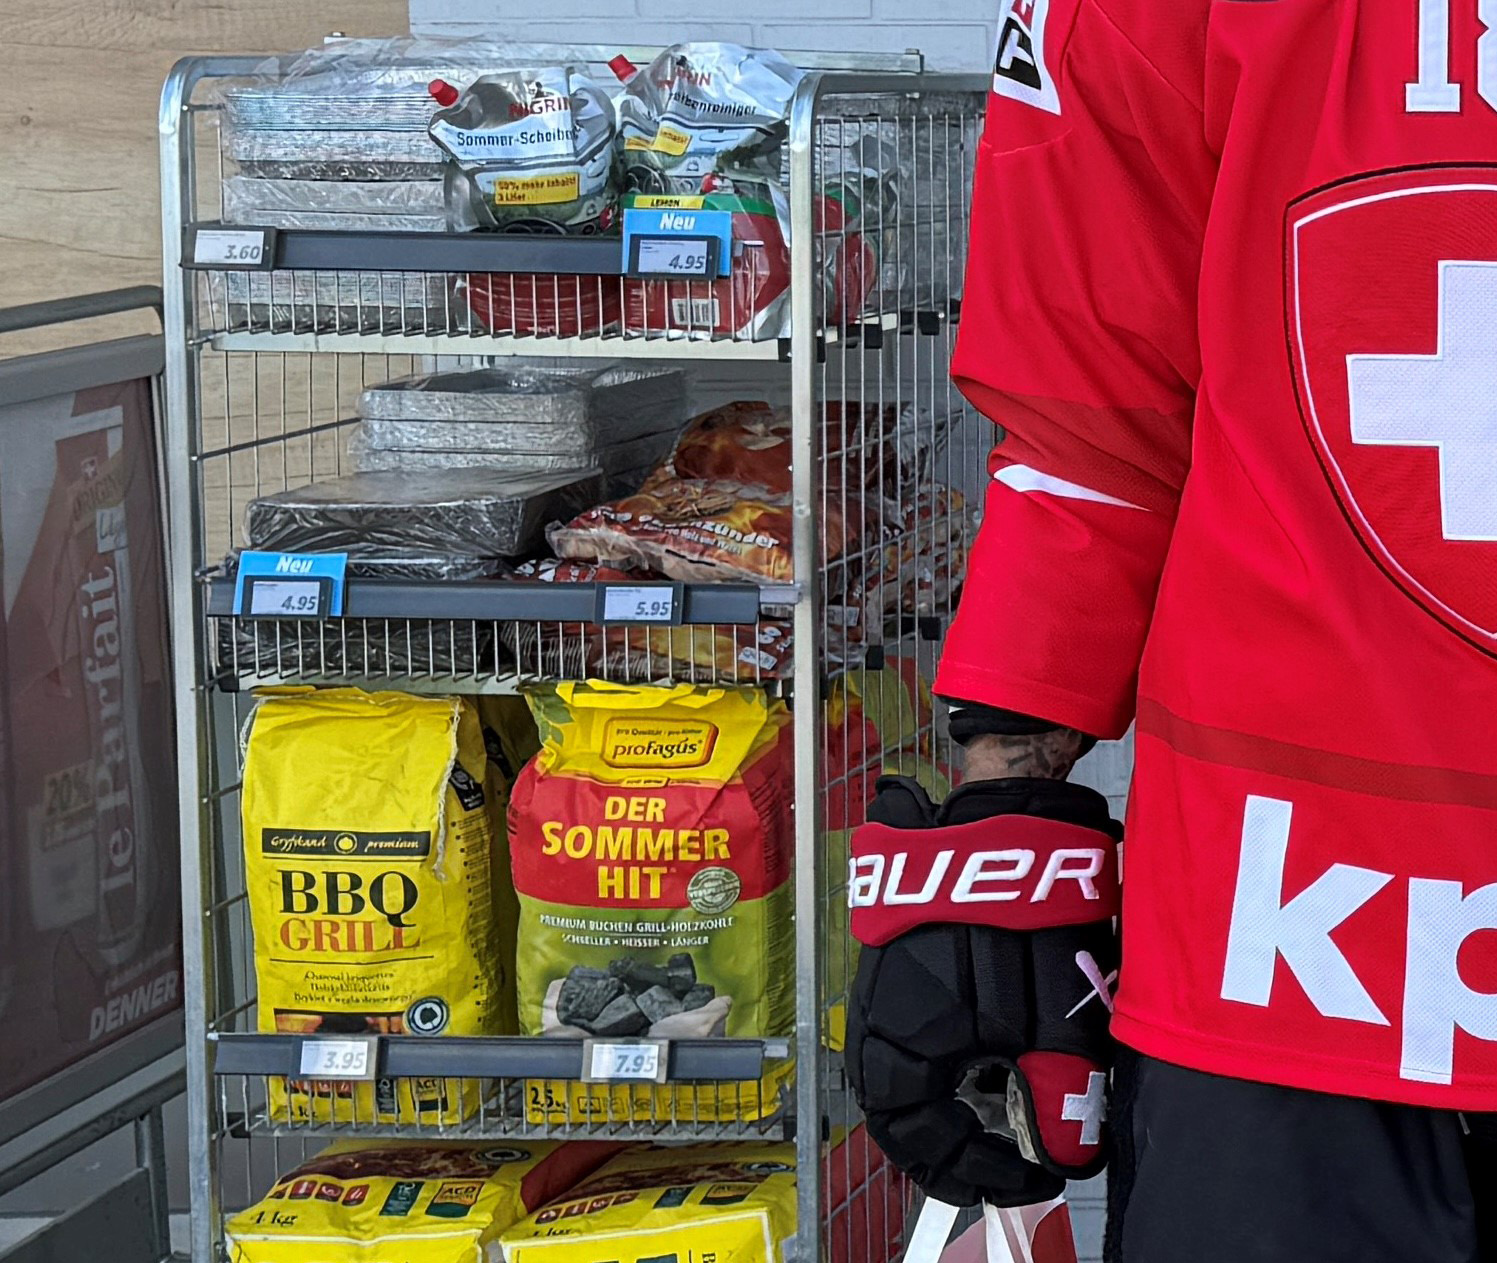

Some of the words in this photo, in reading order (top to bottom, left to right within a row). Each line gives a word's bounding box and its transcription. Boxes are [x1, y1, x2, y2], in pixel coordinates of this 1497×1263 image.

[660, 212, 696, 231] Neu
[224, 244, 261, 260] 3.60
[668, 254, 706, 270] 4.95
[276, 555, 315, 574] Neu
[281, 596, 316, 611] 4.95
[634, 601, 670, 616] 5.95
[604, 796, 667, 823] DER
[364, 837, 419, 853] premium
[541, 821, 731, 862] SOMMER
[597, 866, 668, 900] HIT
[848, 847, 1105, 909] AUER
[276, 869, 419, 928] BBQ
[539, 913, 587, 932] PREMIUM
[589, 920, 634, 933] BUCHEN
[636, 916, 734, 933] GRILL-HOLZKOHLE
[279, 917, 421, 953] GRILL
[621, 938, 661, 948] HEISSER
[670, 935, 709, 947] LÄNGER
[89, 970, 179, 1041] DENNER
[323, 1051, 365, 1070] 3.95
[615, 1054, 656, 1073] 7.95
